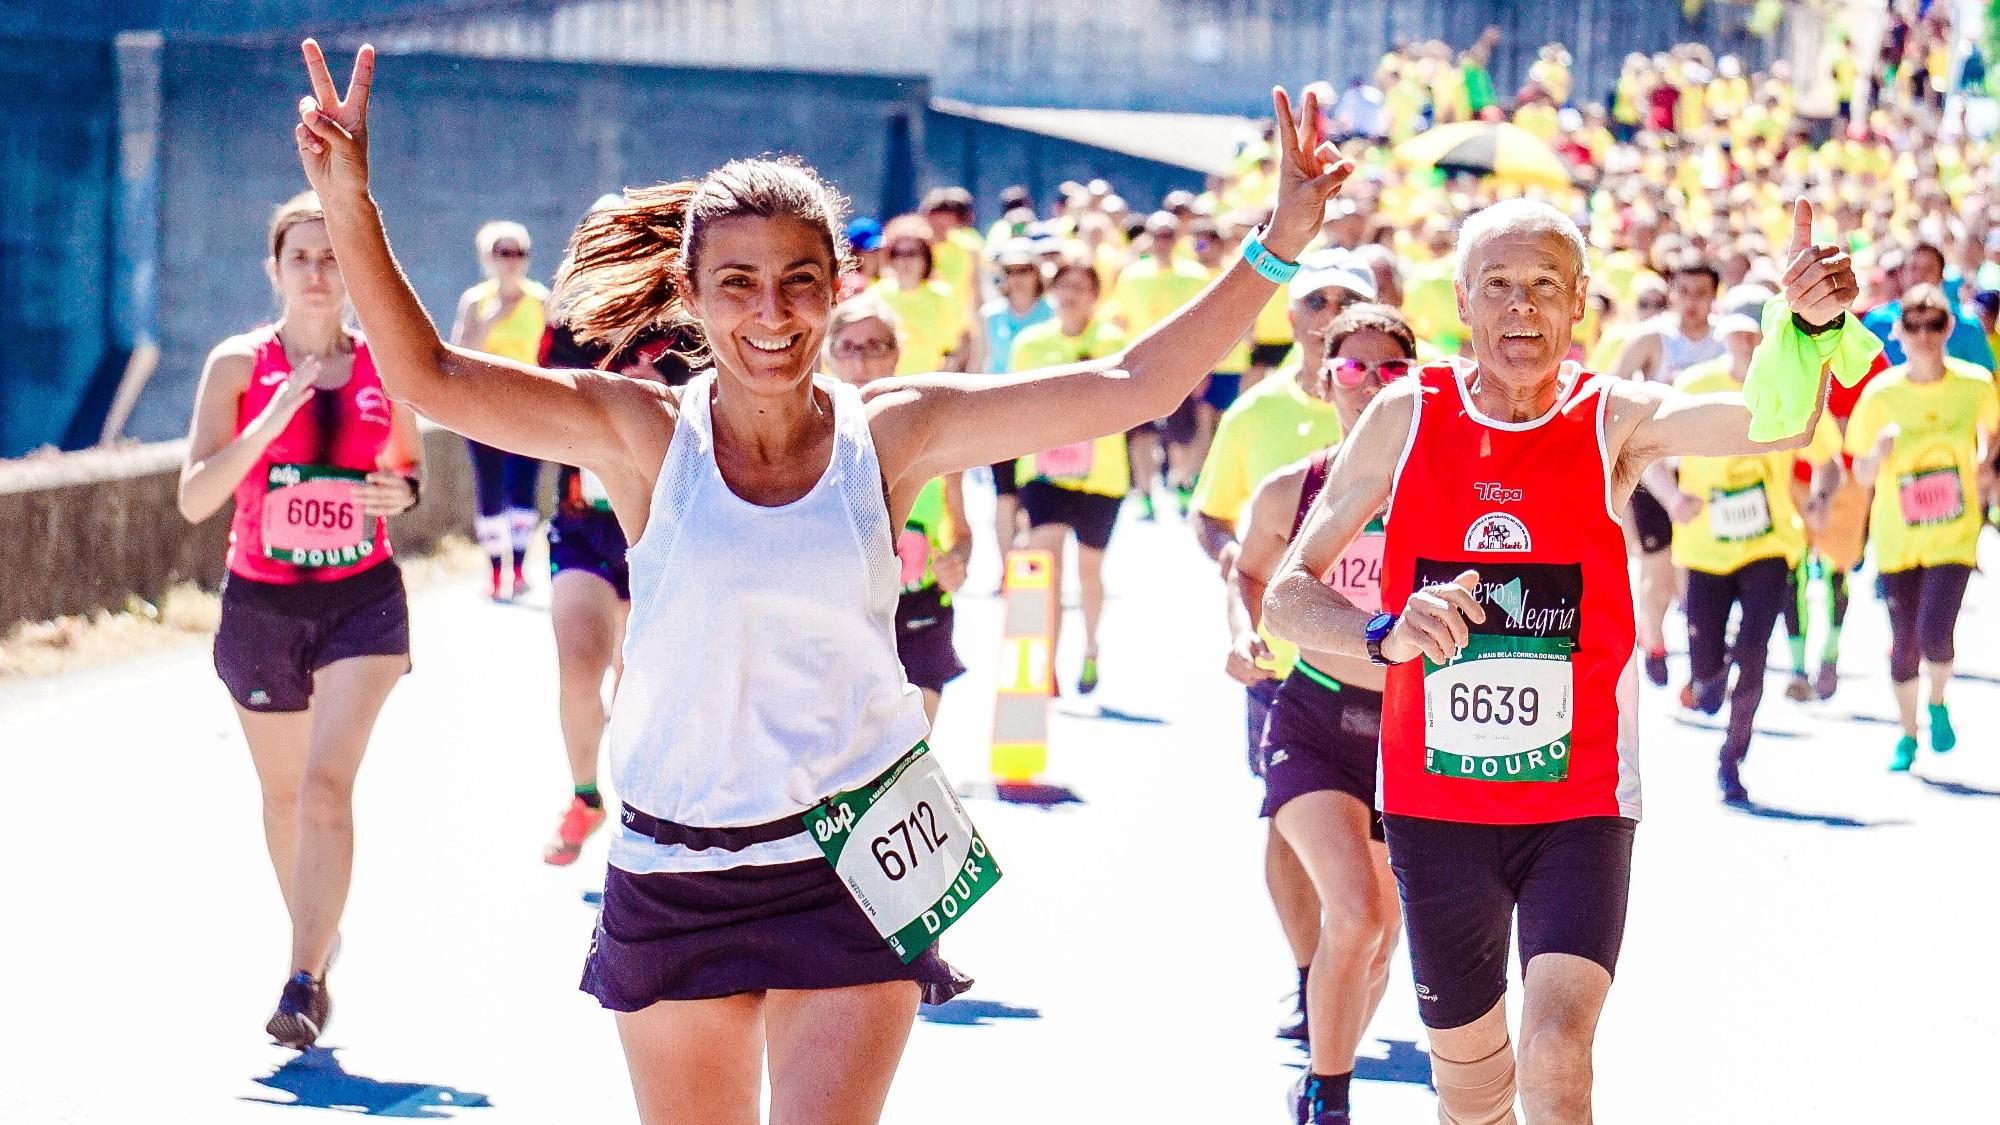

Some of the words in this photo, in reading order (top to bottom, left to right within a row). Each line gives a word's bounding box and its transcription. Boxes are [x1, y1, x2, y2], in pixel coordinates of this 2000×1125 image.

[288, 498, 354, 530] 6056
[292, 540, 374, 566] DOURO
[1328, 558, 1382, 588] 124
[1505, 589, 1575, 637] alegria
[1512, 651, 1539, 660] CORRIDA
[1547, 653, 1567, 661] MUNDO
[1450, 682, 1539, 727] 6639
[1460, 739, 1566, 777] DOURO
[868, 797, 875, 805] A
[872, 785, 886, 800] MAIS
[871, 801, 949, 881] 6712
[920, 836, 986, 935] DOURO
